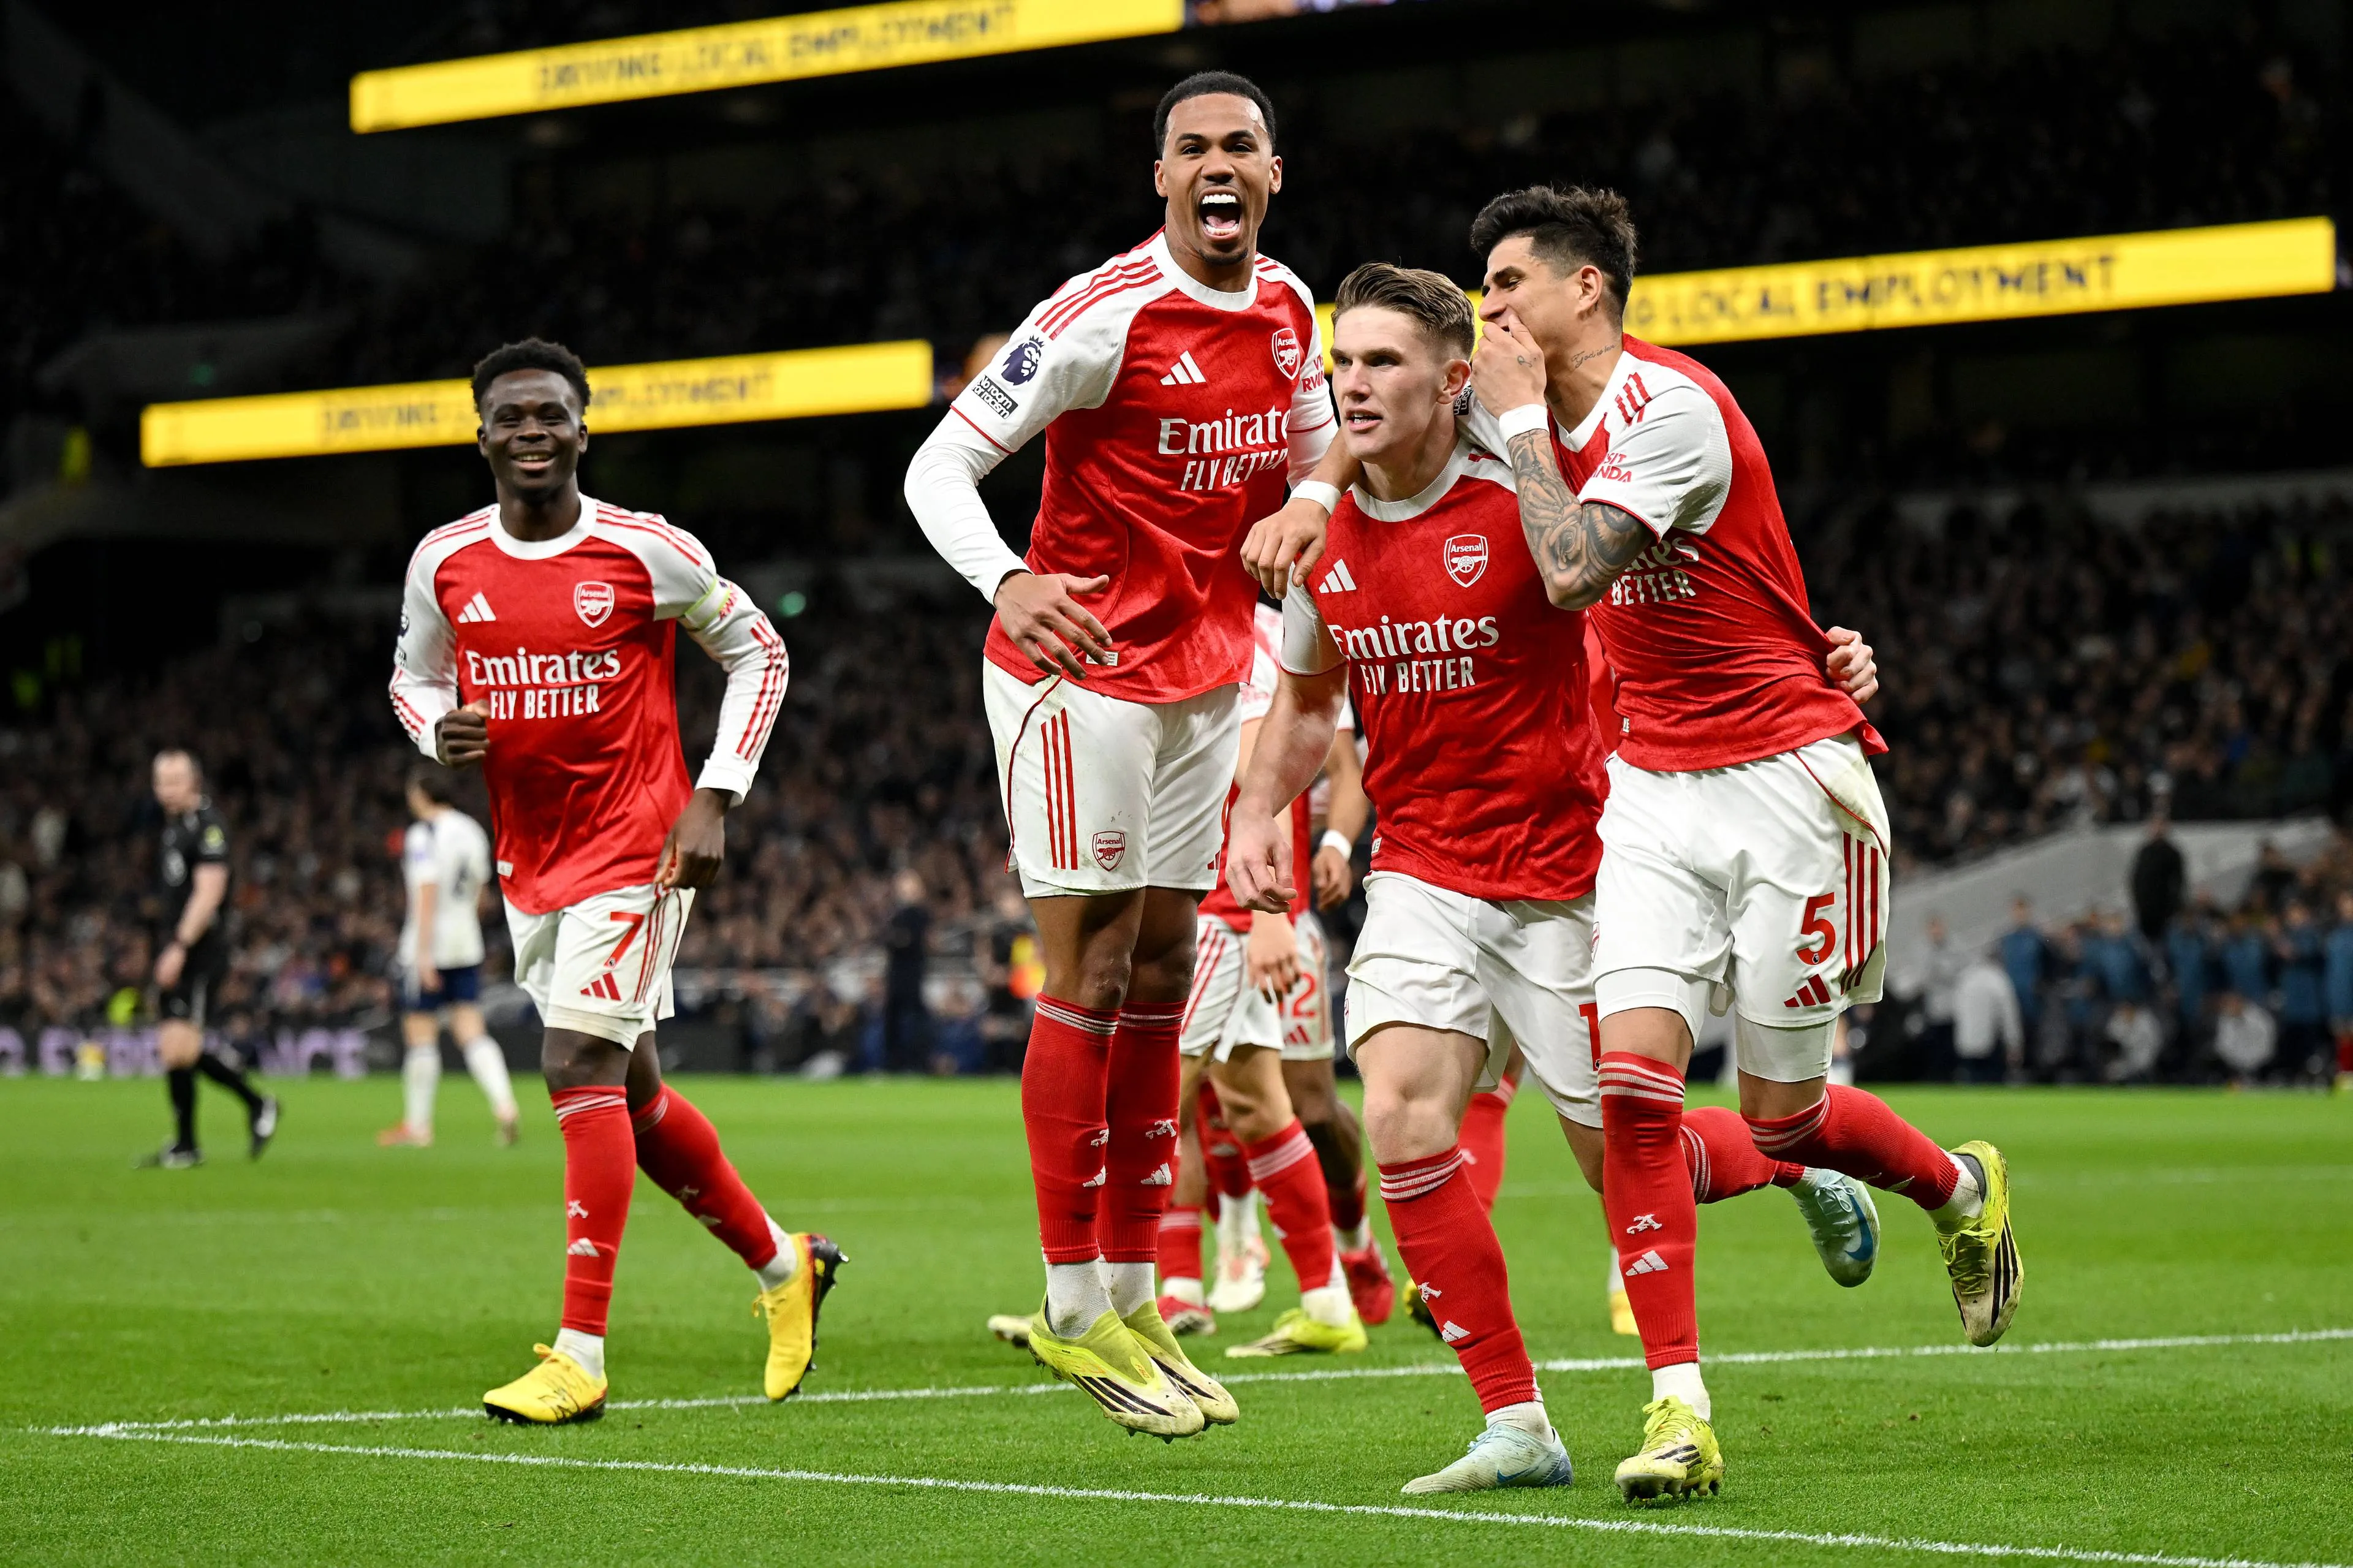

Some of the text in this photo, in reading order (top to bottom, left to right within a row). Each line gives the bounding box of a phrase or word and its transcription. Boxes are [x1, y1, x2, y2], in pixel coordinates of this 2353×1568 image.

[788, 4, 1015, 59] EMPLOYMENT
[1669, 288, 1796, 325] LOCAL
[1816, 254, 2113, 312] EMPLOYMENT
[589, 373, 771, 409] MPLOYMENT
[981, 391, 1010, 419] racism
[987, 385, 1012, 409] room
[1158, 404, 1291, 455] Emirate
[1181, 448, 1288, 491] FLY BETTER
[1604, 453, 1627, 464] SIT
[1450, 543, 1482, 553] Arsenal
[1611, 570, 1696, 605] BETTER
[1327, 613, 1499, 660] Emirates
[465, 646, 621, 686] Emirates
[1360, 656, 1476, 695] FLY BETTER
[490, 684, 600, 720] FLY BETTER
[604, 911, 645, 969] 7
[1797, 892, 1836, 966] 5
[1278, 972, 1317, 1019] 2
